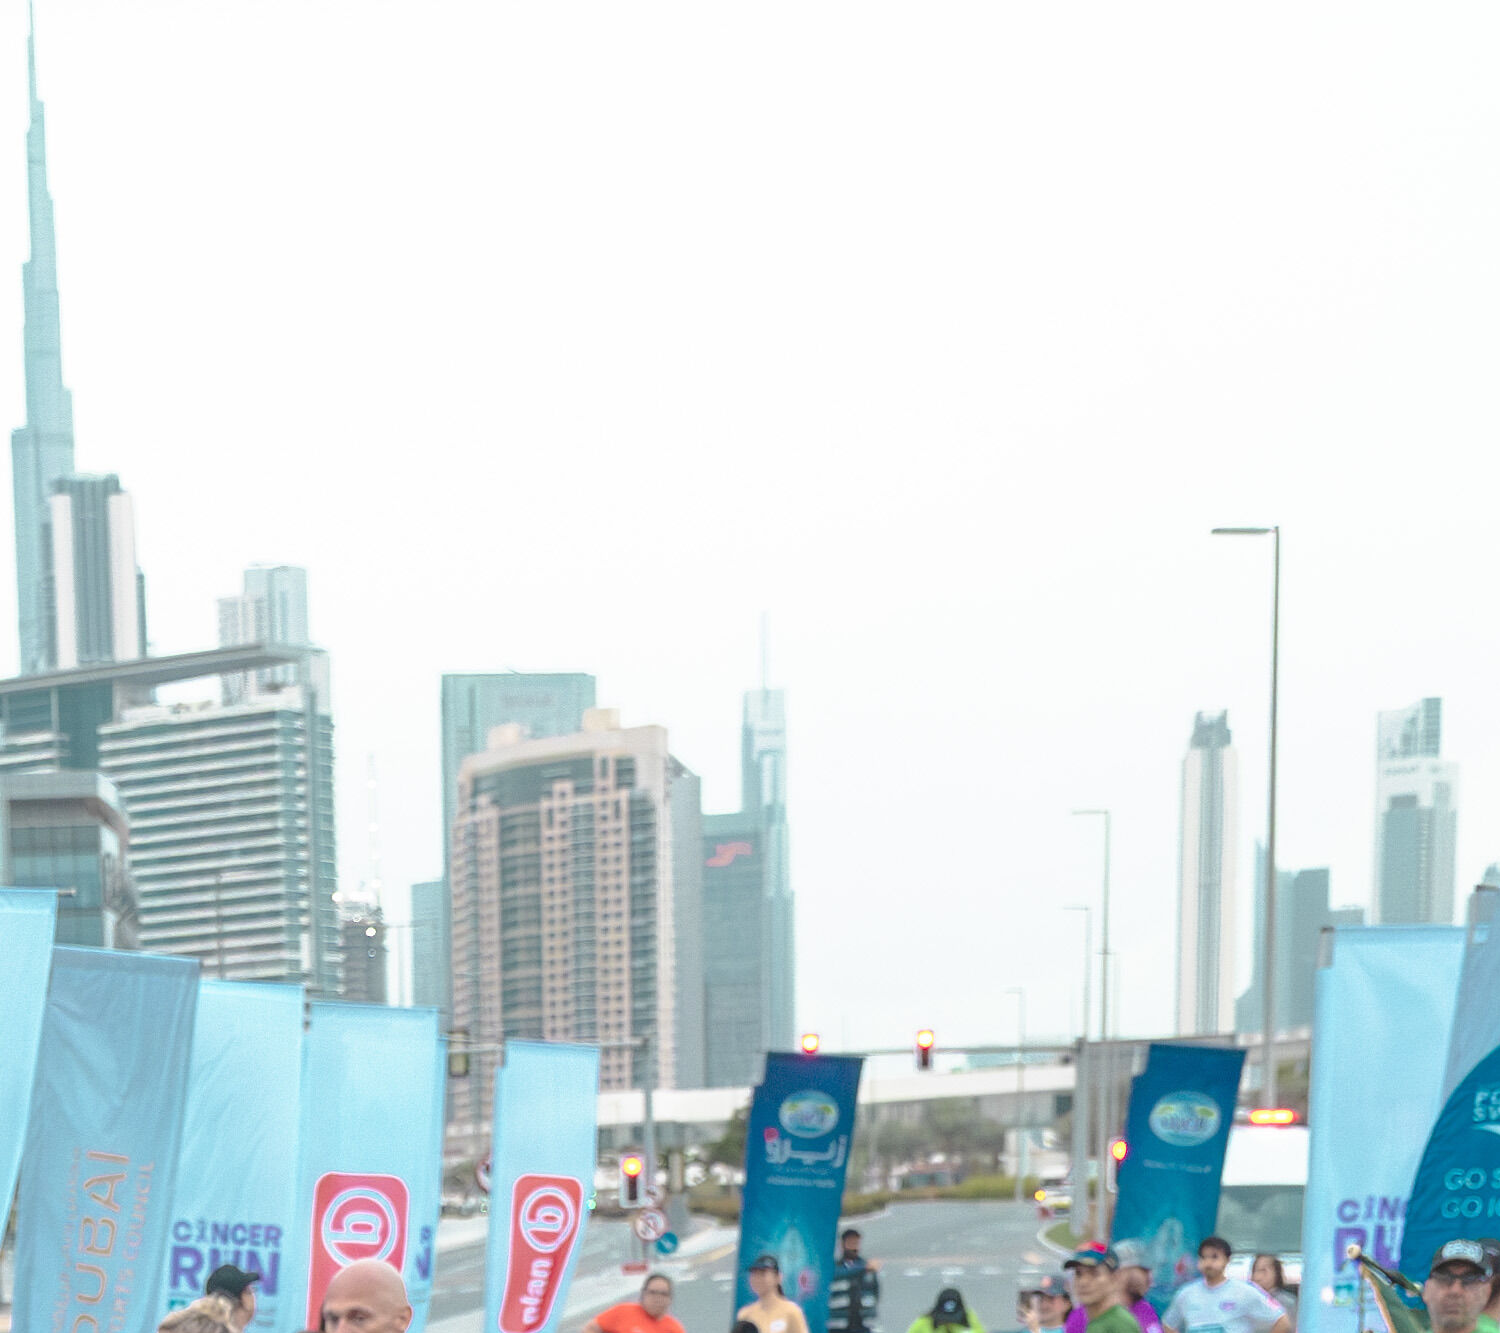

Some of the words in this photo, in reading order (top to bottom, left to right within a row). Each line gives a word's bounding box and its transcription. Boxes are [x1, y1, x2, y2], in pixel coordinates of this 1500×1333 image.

[1444, 1167, 1488, 1190] GO
[1441, 1195, 1484, 1219] GO
[171, 1220, 283, 1248] CANCER
